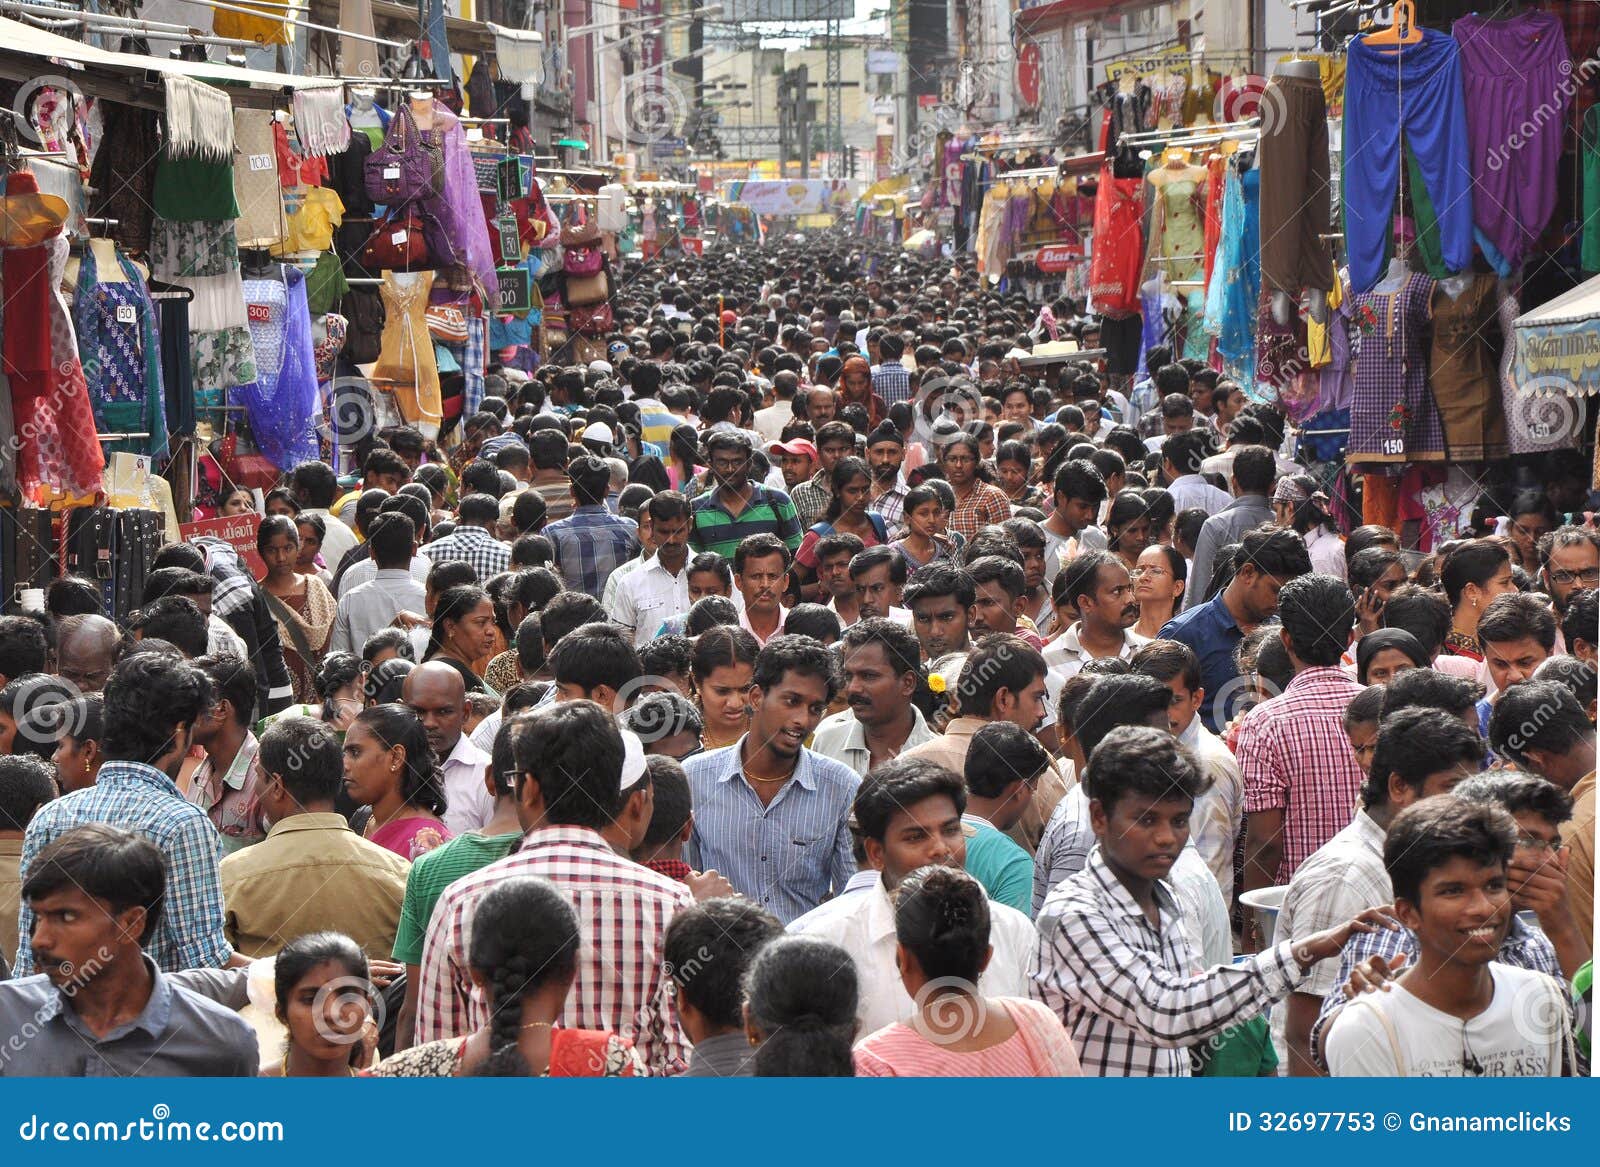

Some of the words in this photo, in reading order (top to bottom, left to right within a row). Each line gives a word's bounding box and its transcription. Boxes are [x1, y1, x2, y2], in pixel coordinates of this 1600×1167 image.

[251, 156, 271, 169] 100
[499, 290, 517, 305] 00
[118, 308, 132, 320] 150
[250, 307, 269, 318] 300
[1528, 423, 1549, 439] 150
[1384, 439, 1404, 454] 150
